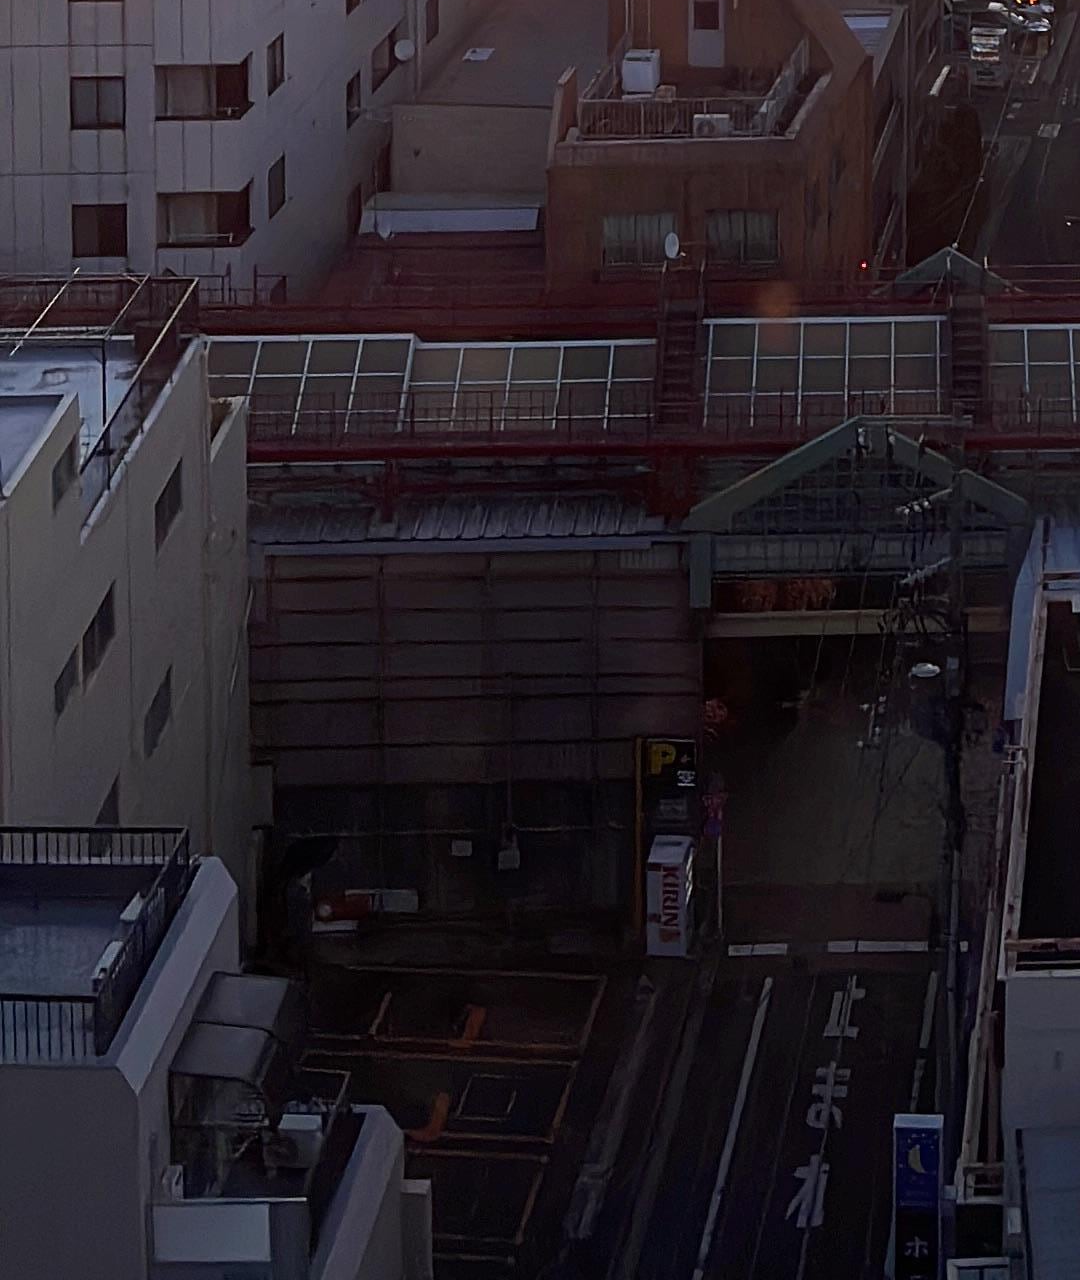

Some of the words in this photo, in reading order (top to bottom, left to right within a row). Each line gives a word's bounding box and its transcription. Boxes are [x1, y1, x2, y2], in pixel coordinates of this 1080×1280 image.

[650, 742, 677, 775] P
[662, 865, 680, 928] KIRIN
[784, 975, 867, 1230] 止まれ
